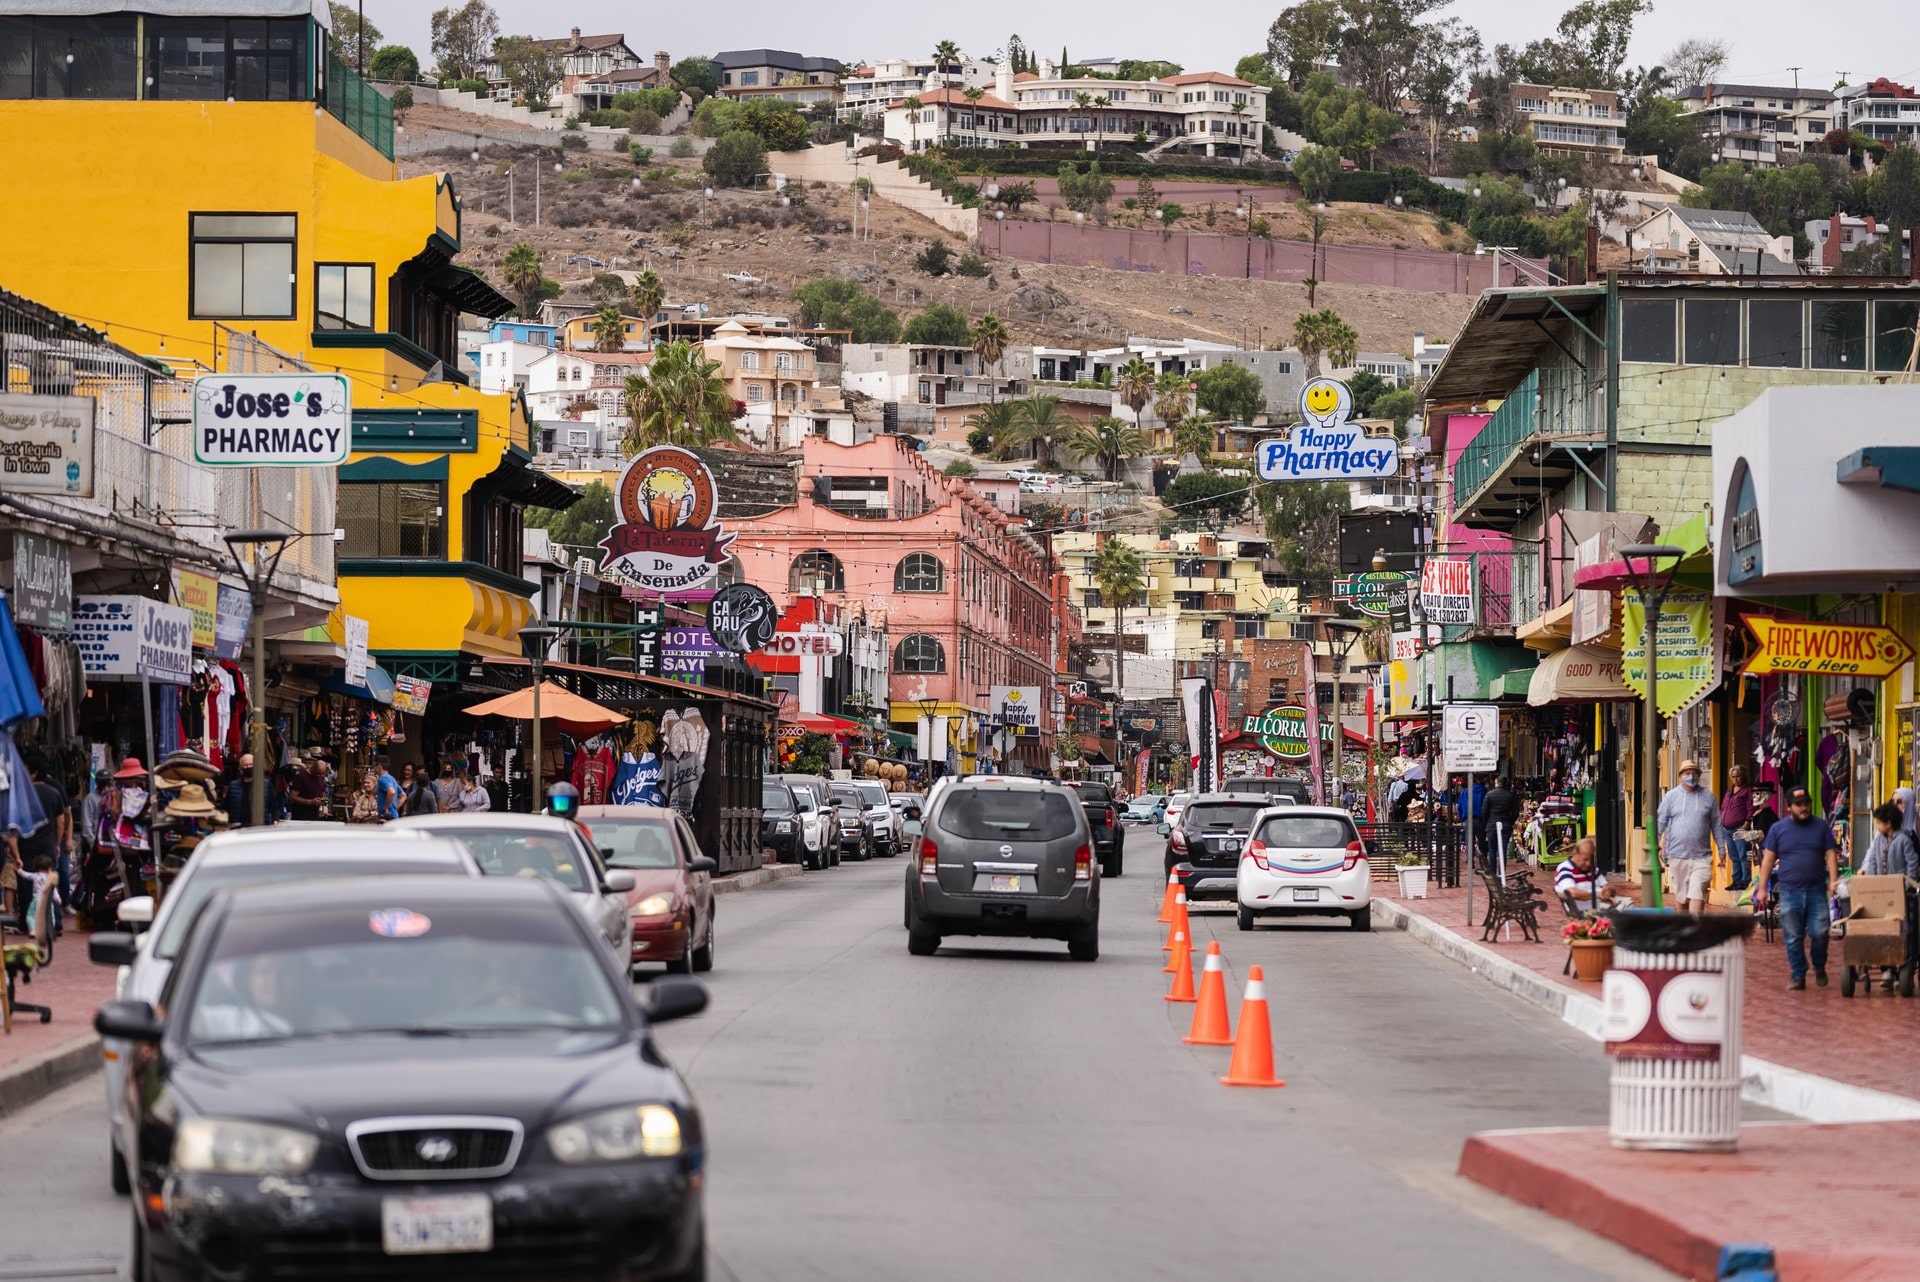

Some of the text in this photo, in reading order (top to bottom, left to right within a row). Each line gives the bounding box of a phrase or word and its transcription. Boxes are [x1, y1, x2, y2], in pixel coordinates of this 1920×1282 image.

[214, 384, 323, 419] Jose's
[204, 428, 341, 453] PHARMACY
[1300, 428, 1357, 450] Happy
[20, 441, 61, 460] Tequila
[5, 456, 50, 474] In Town
[1266, 444, 1393, 476] Pharmacy
[639, 530, 706, 549] Taberna
[616, 556, 711, 589] Ensenada
[653, 559, 674, 571] De
[1365, 571, 1406, 580] RESTAURANTE
[1423, 560, 1471, 596] SE VENDE
[1423, 594, 1470, 610] TRATO DIRECTO
[1673, 593, 1707, 603] PRICES
[712, 600, 729, 616] CA
[144, 606, 188, 650] Jose's
[712, 616, 740, 631] PAU
[1644, 625, 1691, 634] SIMSUITS
[662, 631, 719, 646] HOTE
[765, 636, 837, 653] HOTEL
[1639, 636, 1697, 646] SATSHIRTS
[1766, 626, 1877, 661] FIREWORKS
[1396, 640, 1412, 657] 35%
[1675, 649, 1699, 657] MORE
[140, 645, 190, 672] PHARMACY
[1770, 657, 1859, 672] Sold Here
[1566, 663, 1593, 677] GOOD
[1274, 709, 1307, 718] RESTAURAN
[777, 727, 805, 736] OXXO
[1244, 716, 1335, 741] EL CORRATO
[1465, 717, 1476, 730] E
